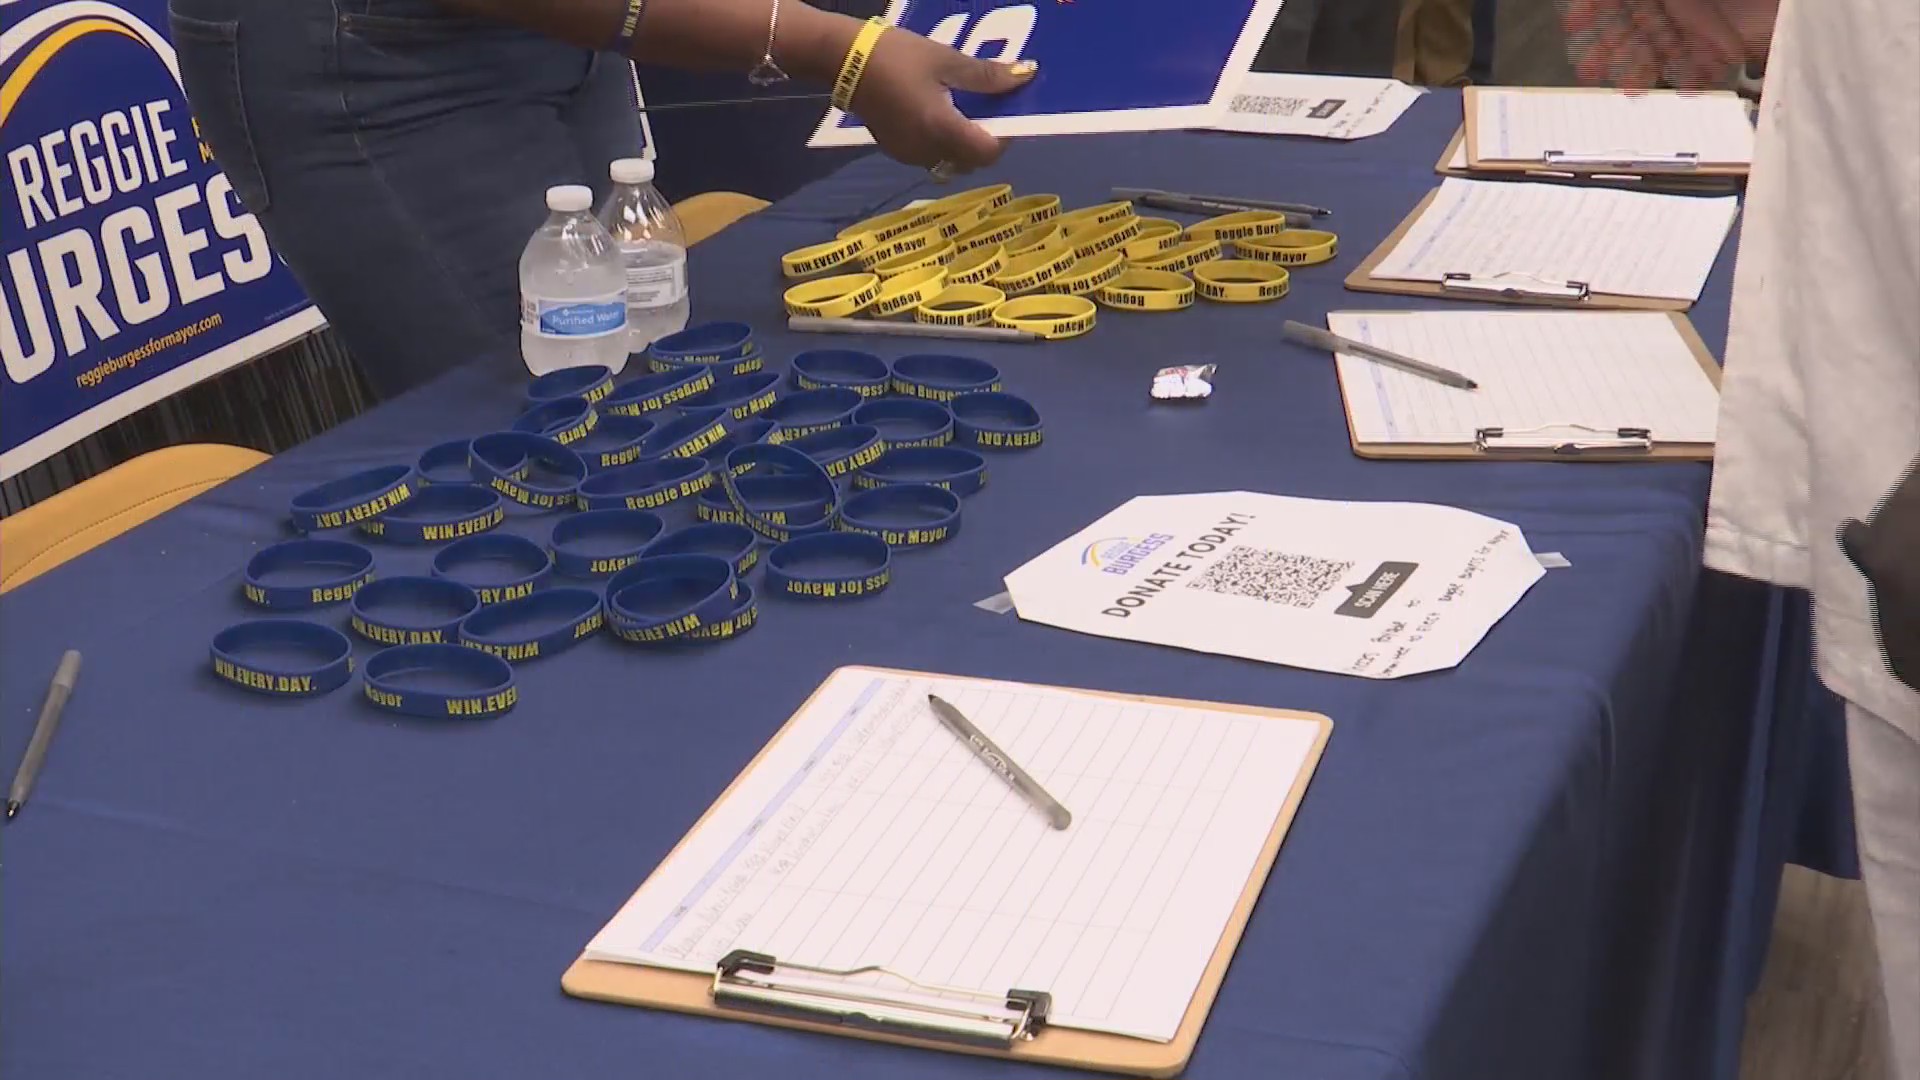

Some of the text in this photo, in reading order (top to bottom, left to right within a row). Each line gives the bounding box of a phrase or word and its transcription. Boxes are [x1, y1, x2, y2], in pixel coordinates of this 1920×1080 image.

[7, 98, 188, 230] REGGIE
[1214, 222, 1283, 241] Reggie Burg
[876, 236, 927, 263] for Mayor
[1186, 246, 1221, 268] Burge
[1253, 247, 1271, 262] for
[1271, 249, 1308, 263] Mayor
[0, 172, 289, 384] URGES
[1258, 283, 1289, 299] Regg
[552, 313, 596, 326] Purified
[1052, 319, 1086, 334] Mayor
[76, 312, 223, 388] reggieburgessformayor.com
[642, 396, 663, 411] for
[917, 383, 957, 401] Burge
[601, 446, 642, 467] Reggi
[490, 475, 554, 509] Mayor for
[626, 487, 678, 510] Reggie
[679, 472, 714, 496] Burg
[311, 483, 411, 529] WIN.EVERY.DAY.
[421, 506, 504, 541] WIN.EVERY.D
[882, 526, 948, 545] for Mayor
[1101, 532, 1175, 576] BURGESS
[1101, 512, 1257, 618] DONATE TODAY!
[787, 580, 865, 597] for Mayor
[1353, 571, 1401, 609] SCAN HERE
[214, 656, 318, 693] WIN.EVERY.DAY.
[445, 686, 518, 715] WIN.EVE
